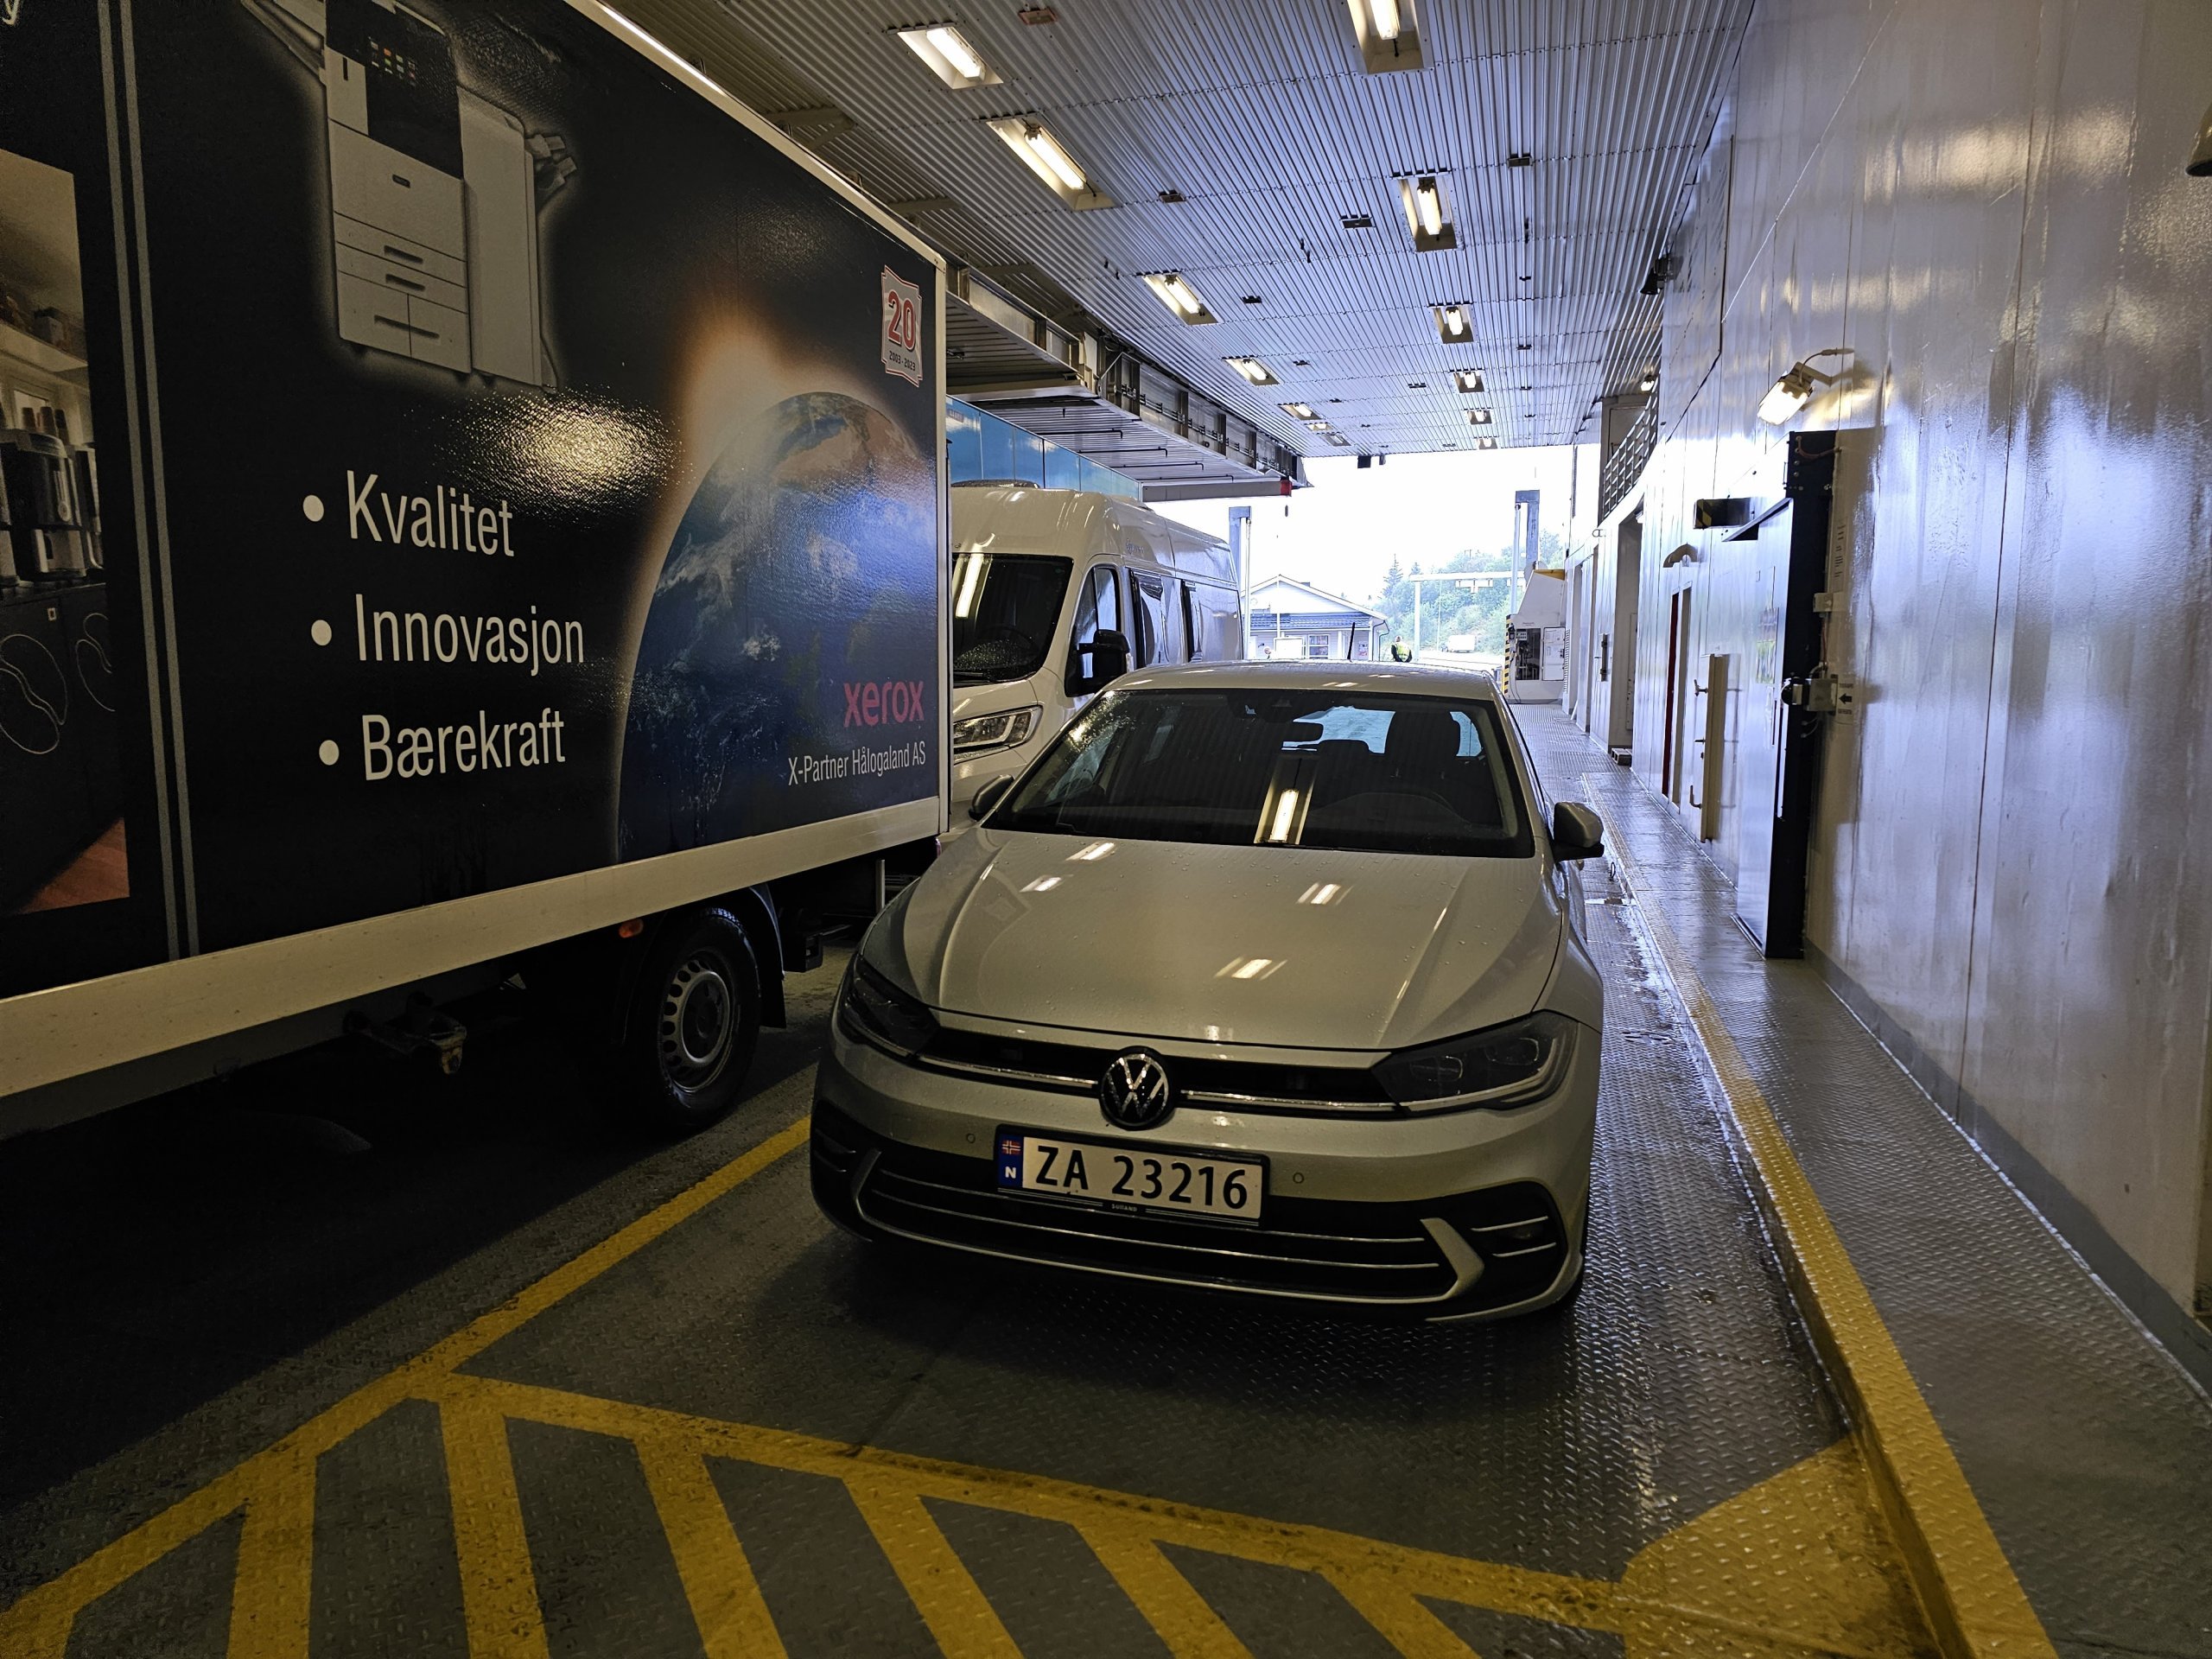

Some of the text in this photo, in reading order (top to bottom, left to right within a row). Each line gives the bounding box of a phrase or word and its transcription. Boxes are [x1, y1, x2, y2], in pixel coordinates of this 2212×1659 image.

[887, 289, 915, 351] 20
[346, 470, 514, 556] Kvalitet
[355, 594, 585, 676] Innovasjon
[843, 681, 924, 728] xerox
[361, 708, 565, 780] Bærekraft
[788, 741, 926, 785] X-Partner Hålogaland AS
[1005, 1166, 1016, 1179] N
[1036, 1146, 1248, 1209] ZA 23216
